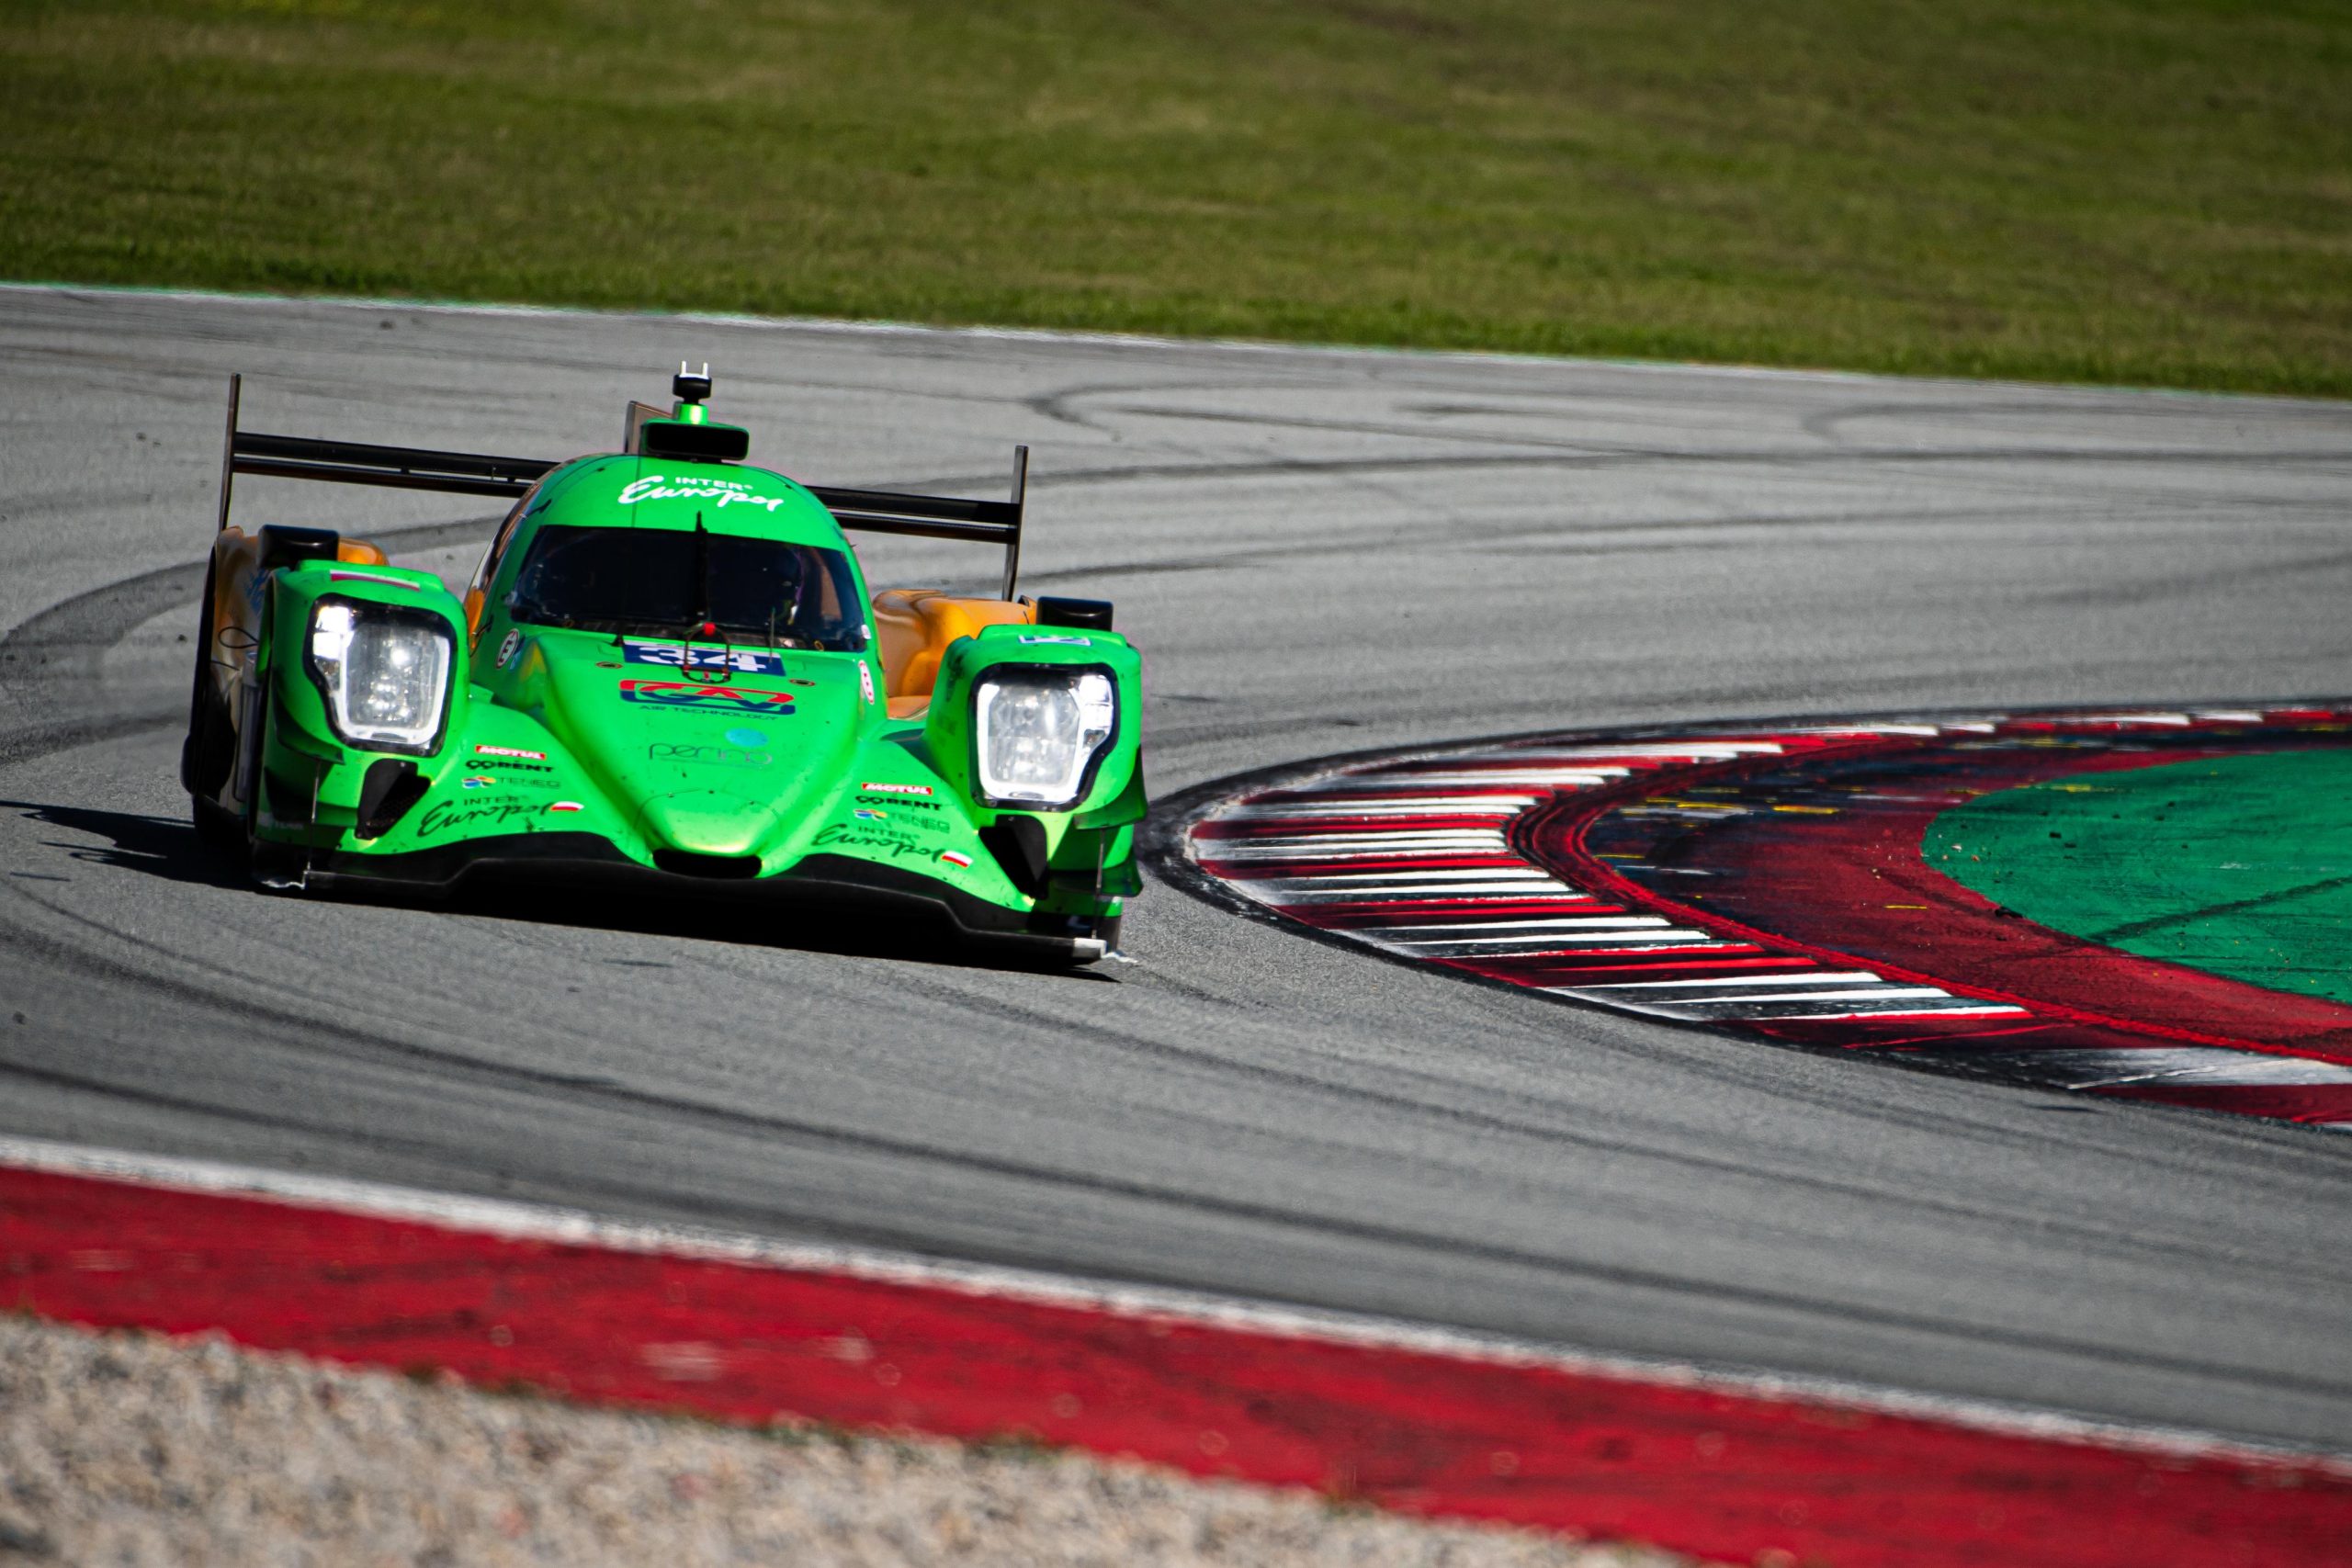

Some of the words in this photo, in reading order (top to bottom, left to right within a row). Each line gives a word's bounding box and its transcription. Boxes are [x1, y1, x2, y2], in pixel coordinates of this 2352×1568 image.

[639, 646, 767, 671] 34
[477, 746, 542, 760] MOTUL
[865, 783, 930, 795] MOTUL
